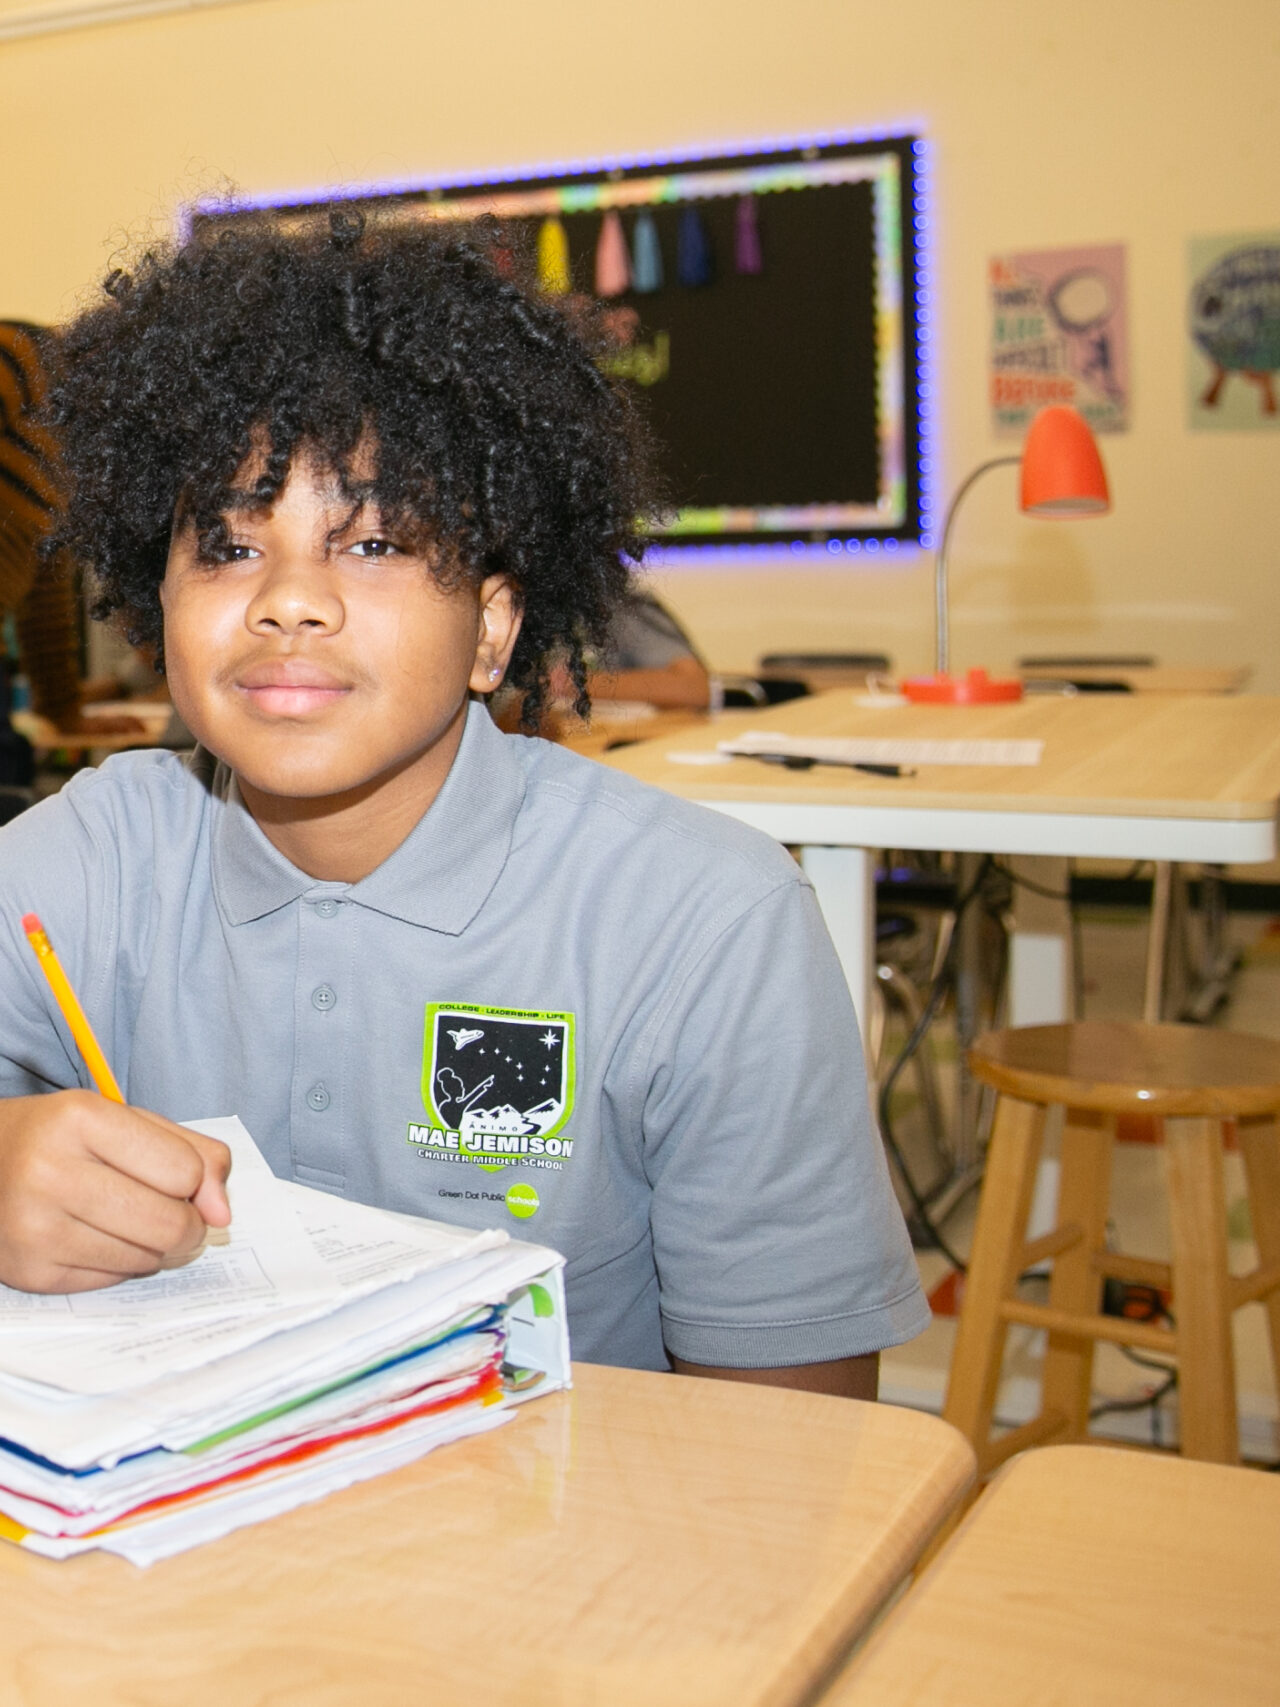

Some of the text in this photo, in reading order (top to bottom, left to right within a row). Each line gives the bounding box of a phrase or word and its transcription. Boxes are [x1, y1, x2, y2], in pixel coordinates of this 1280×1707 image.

[438, 1004, 480, 1012] COLLEGE
[486, 1008, 539, 1018] LEADERSHIP
[408, 1125, 574, 1158] MAE JEMISON
[417, 1149, 564, 1171] CHARTER MIDDLE SCHOOL
[438, 1189, 540, 1207] Green Dot Public schools
